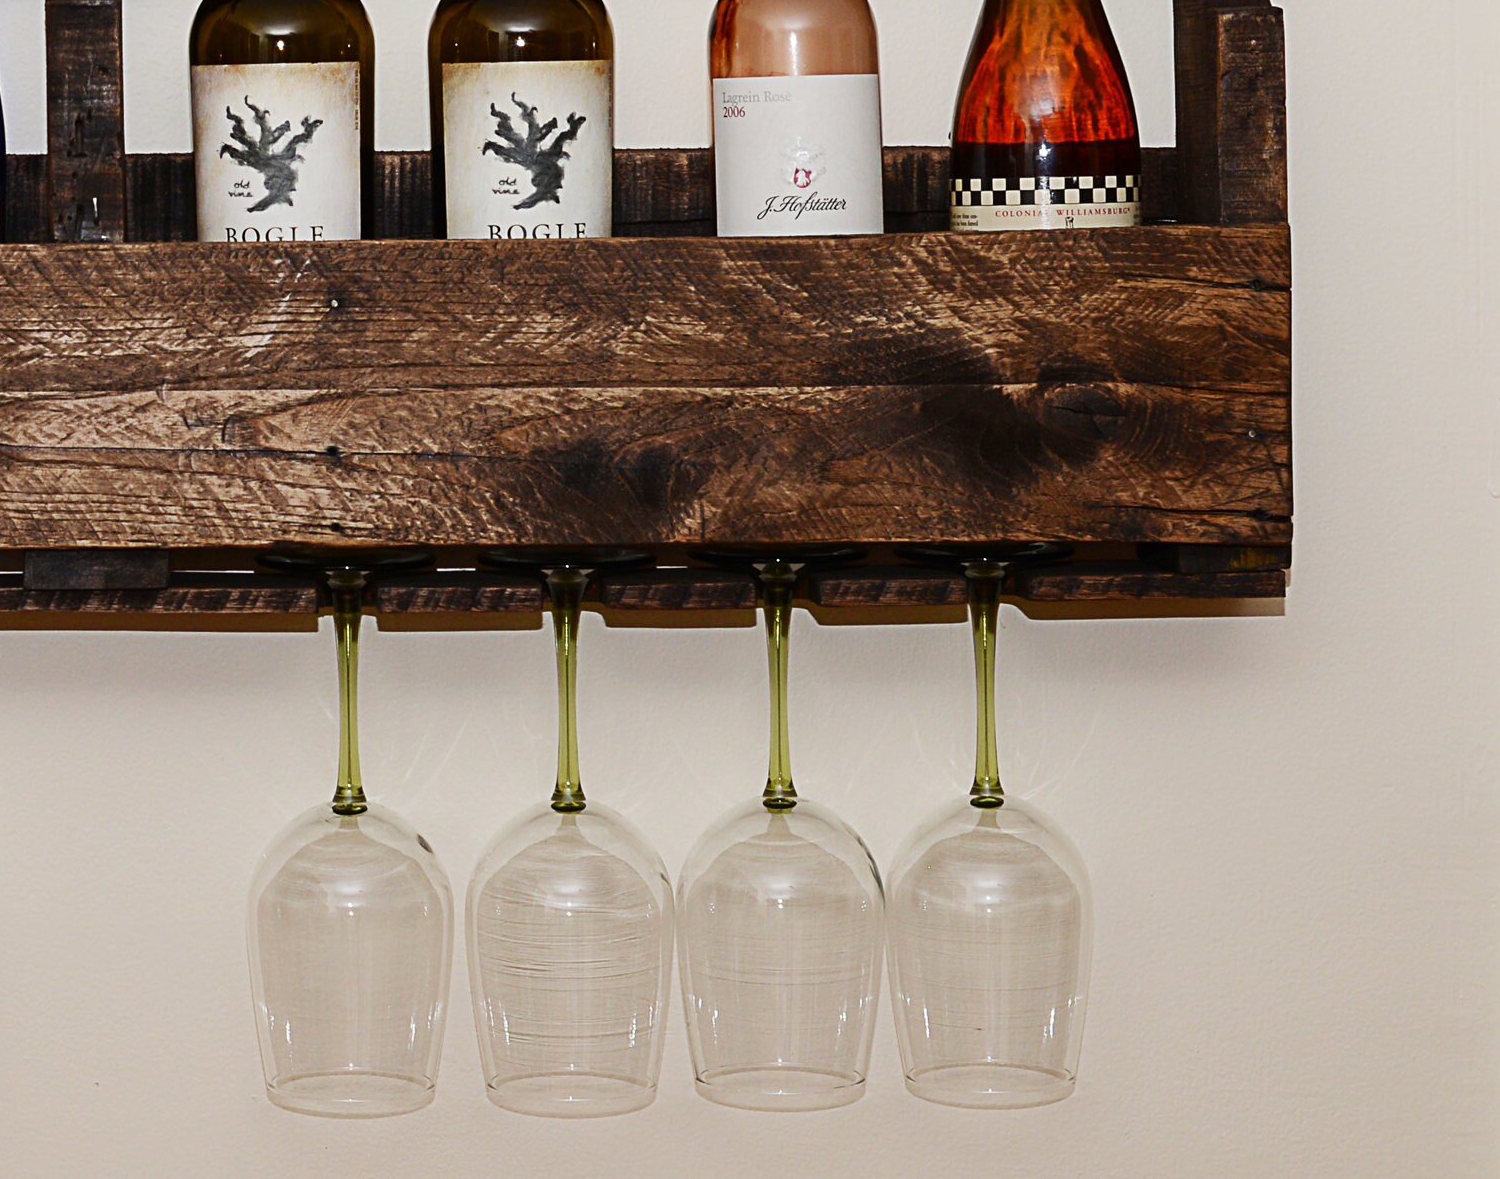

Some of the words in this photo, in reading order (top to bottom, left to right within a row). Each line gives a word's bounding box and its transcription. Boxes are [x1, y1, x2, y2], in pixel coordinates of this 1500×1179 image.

[722, 90, 760, 107] Lagrein
[723, 106, 746, 118] 2006
[233, 179, 250, 189] old
[498, 177, 517, 186] old
[228, 190, 253, 198] vine
[995, 209, 1049, 218] COLONIA
